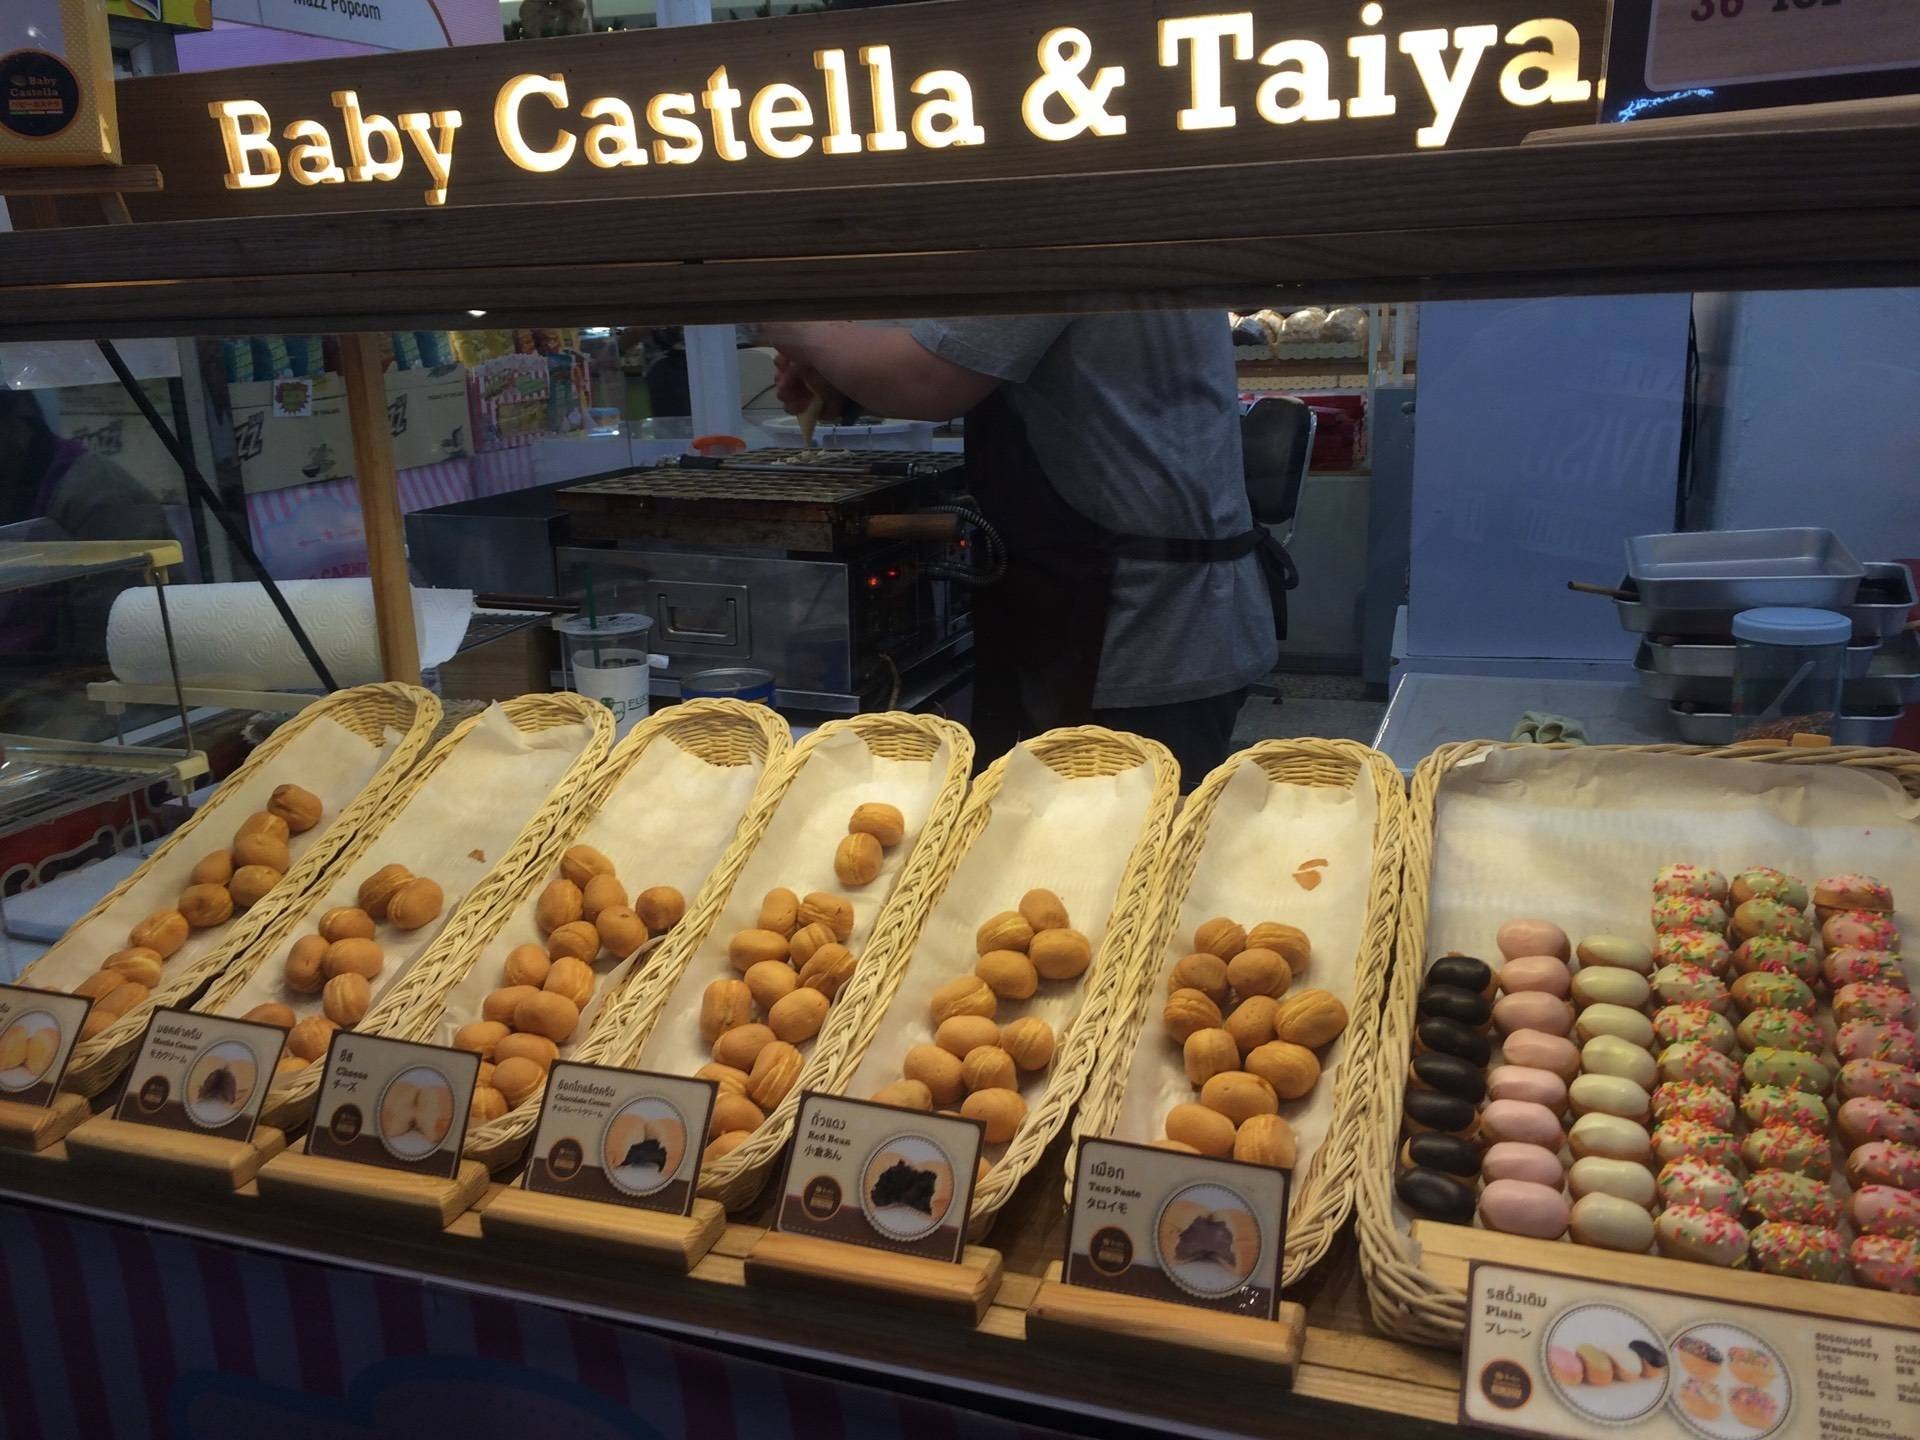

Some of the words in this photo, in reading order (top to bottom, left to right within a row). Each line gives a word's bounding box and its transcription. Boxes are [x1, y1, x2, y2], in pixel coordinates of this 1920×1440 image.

[208, 90, 462, 206] Baby
[493, 44, 985, 173] Castella
[1021, 26, 1127, 142] &
[1157, 1, 1605, 149] Taiya
[808, 1131, 827, 1141] Red
[828, 1135, 851, 1146] Bean
[1089, 1182, 1112, 1193] Taro
[1114, 1186, 1142, 1198] Paste
[1485, 1305, 1522, 1320] Plain
[1815, 1342, 1879, 1361] Strawberry
[1818, 1381, 1876, 1398] Chocolate
